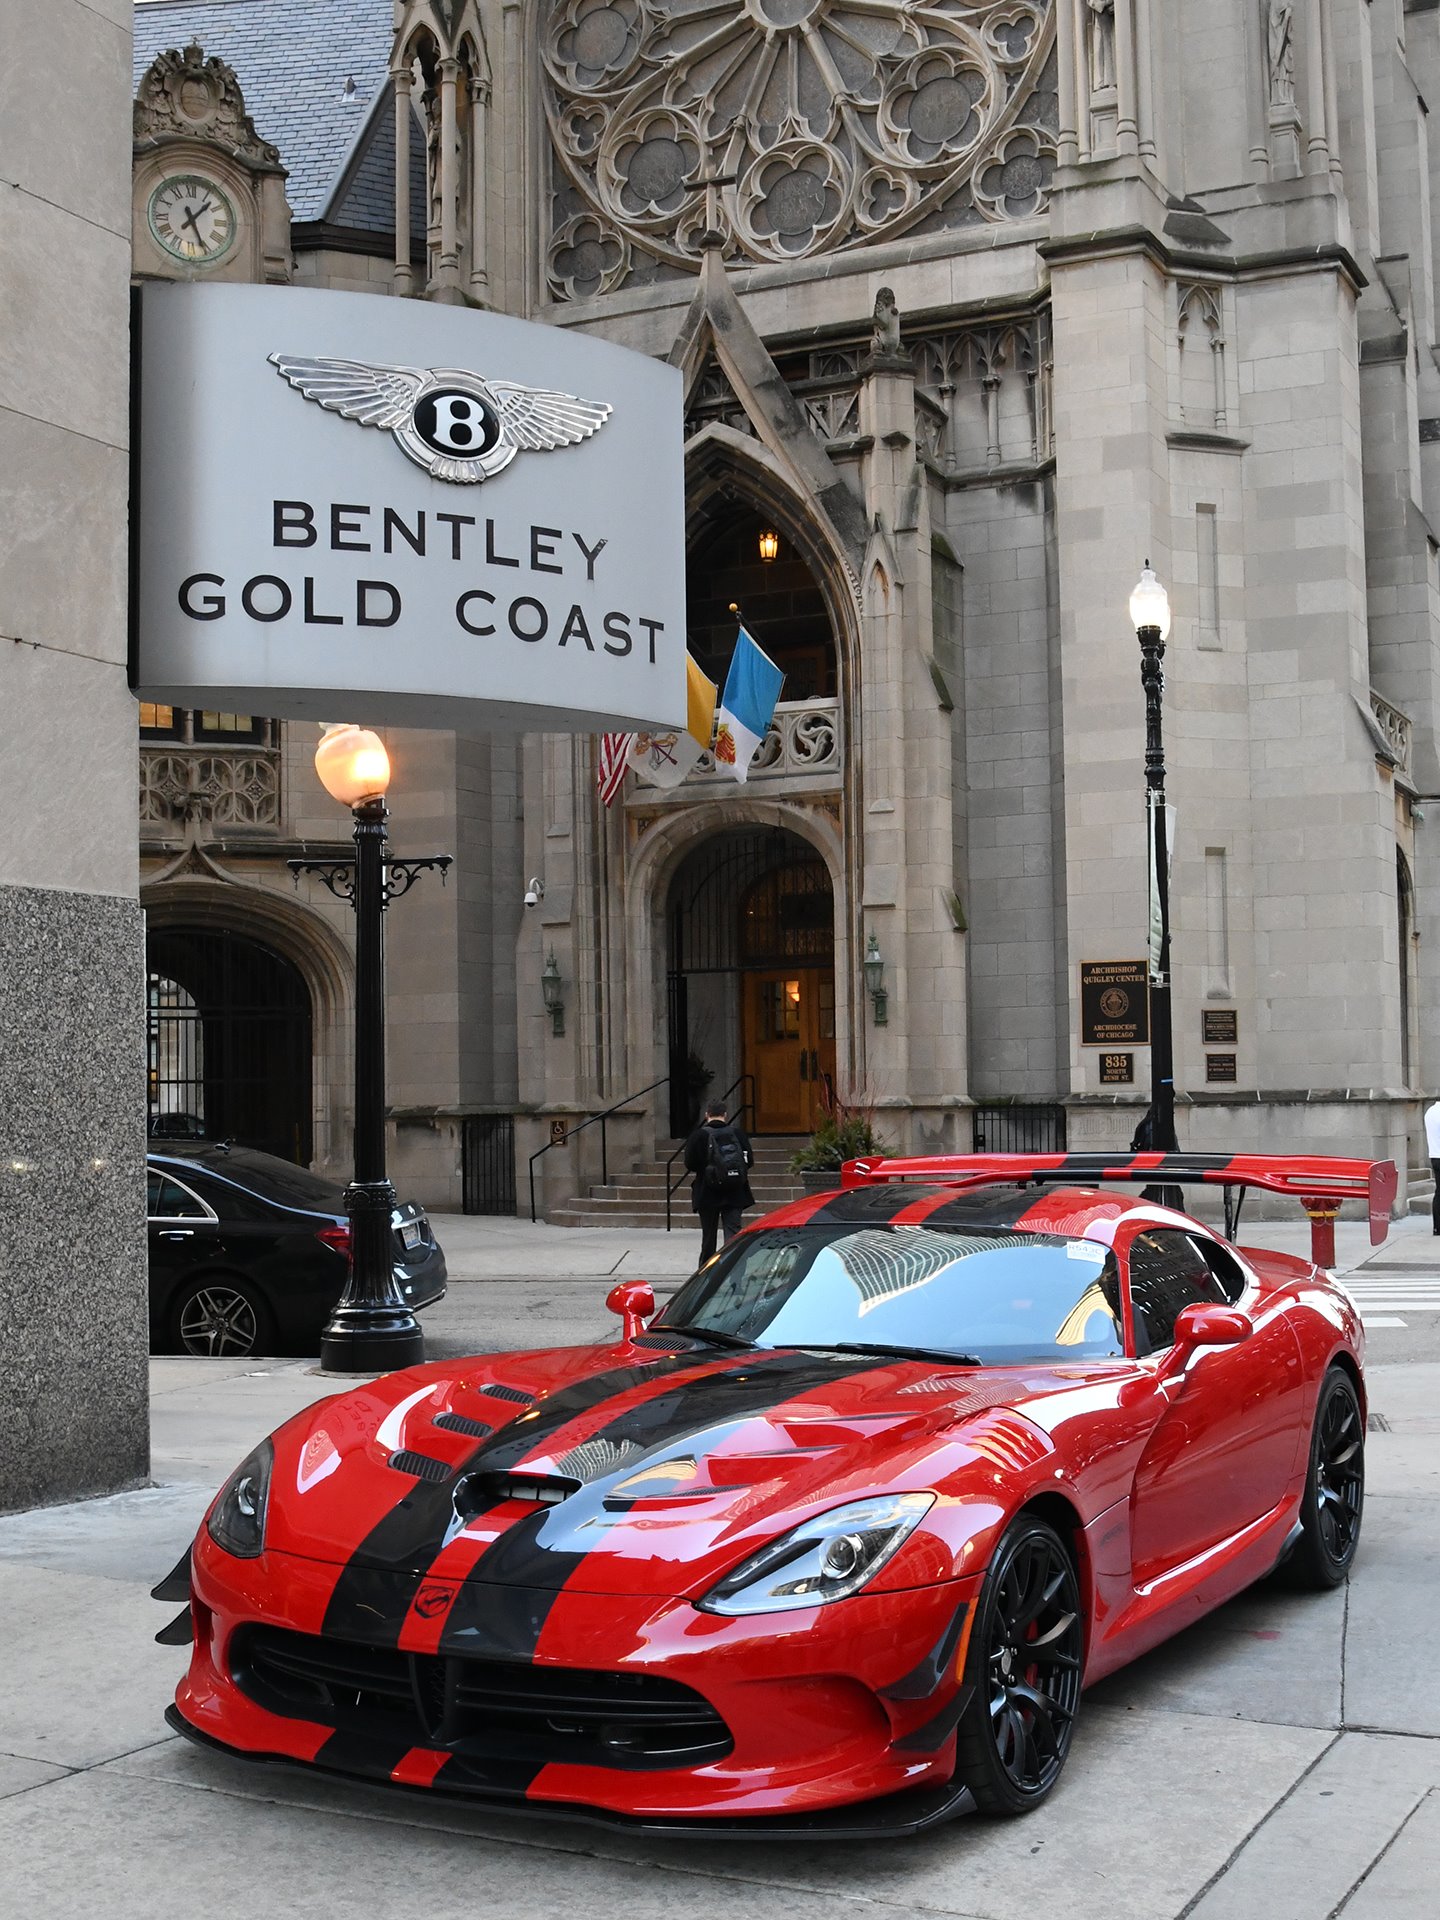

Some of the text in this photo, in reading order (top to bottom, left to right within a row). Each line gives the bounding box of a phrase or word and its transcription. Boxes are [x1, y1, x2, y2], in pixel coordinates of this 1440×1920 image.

[431, 394, 487, 452] B
[272, 499, 609, 581] BENTLEY
[177, 572, 665, 665] GOLD COAST
[1091, 966, 1137, 974] ARCHBISHOP
[1083, 976, 1115, 984] QUIGLEY
[1106, 1031, 1134, 1039] CHICAGO
[1105, 1055, 1127, 1068] 835
